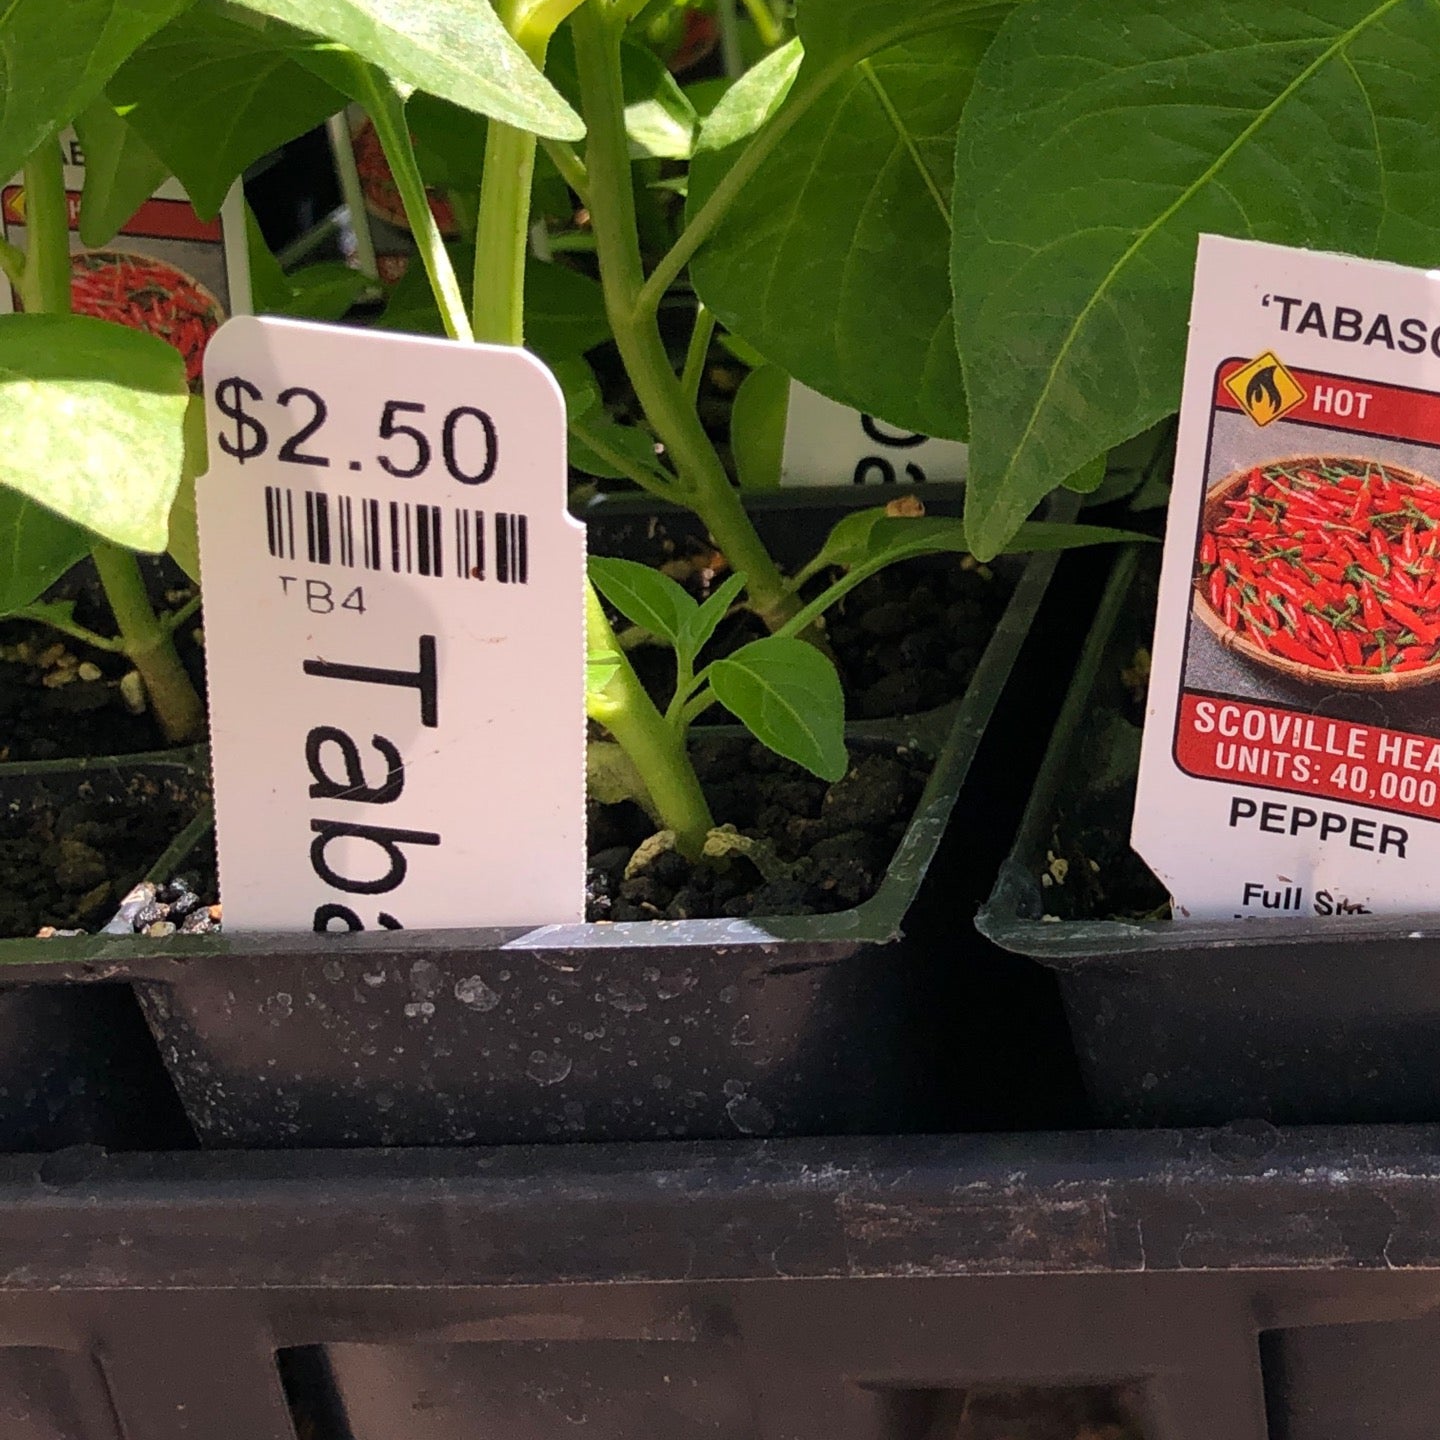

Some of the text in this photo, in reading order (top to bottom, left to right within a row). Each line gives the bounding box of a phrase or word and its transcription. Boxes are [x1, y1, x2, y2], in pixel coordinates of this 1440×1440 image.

[214, 375, 498, 486] $2.50
[1312, 384, 1373, 420] HOT
[278, 575, 367, 615] TB4
[1193, 701, 1369, 760] SCOVILLE
[1215, 741, 1438, 808] UNITS: 40,000
[1229, 796, 1409, 859] PEPPER
[1242, 882, 1303, 911] Full
